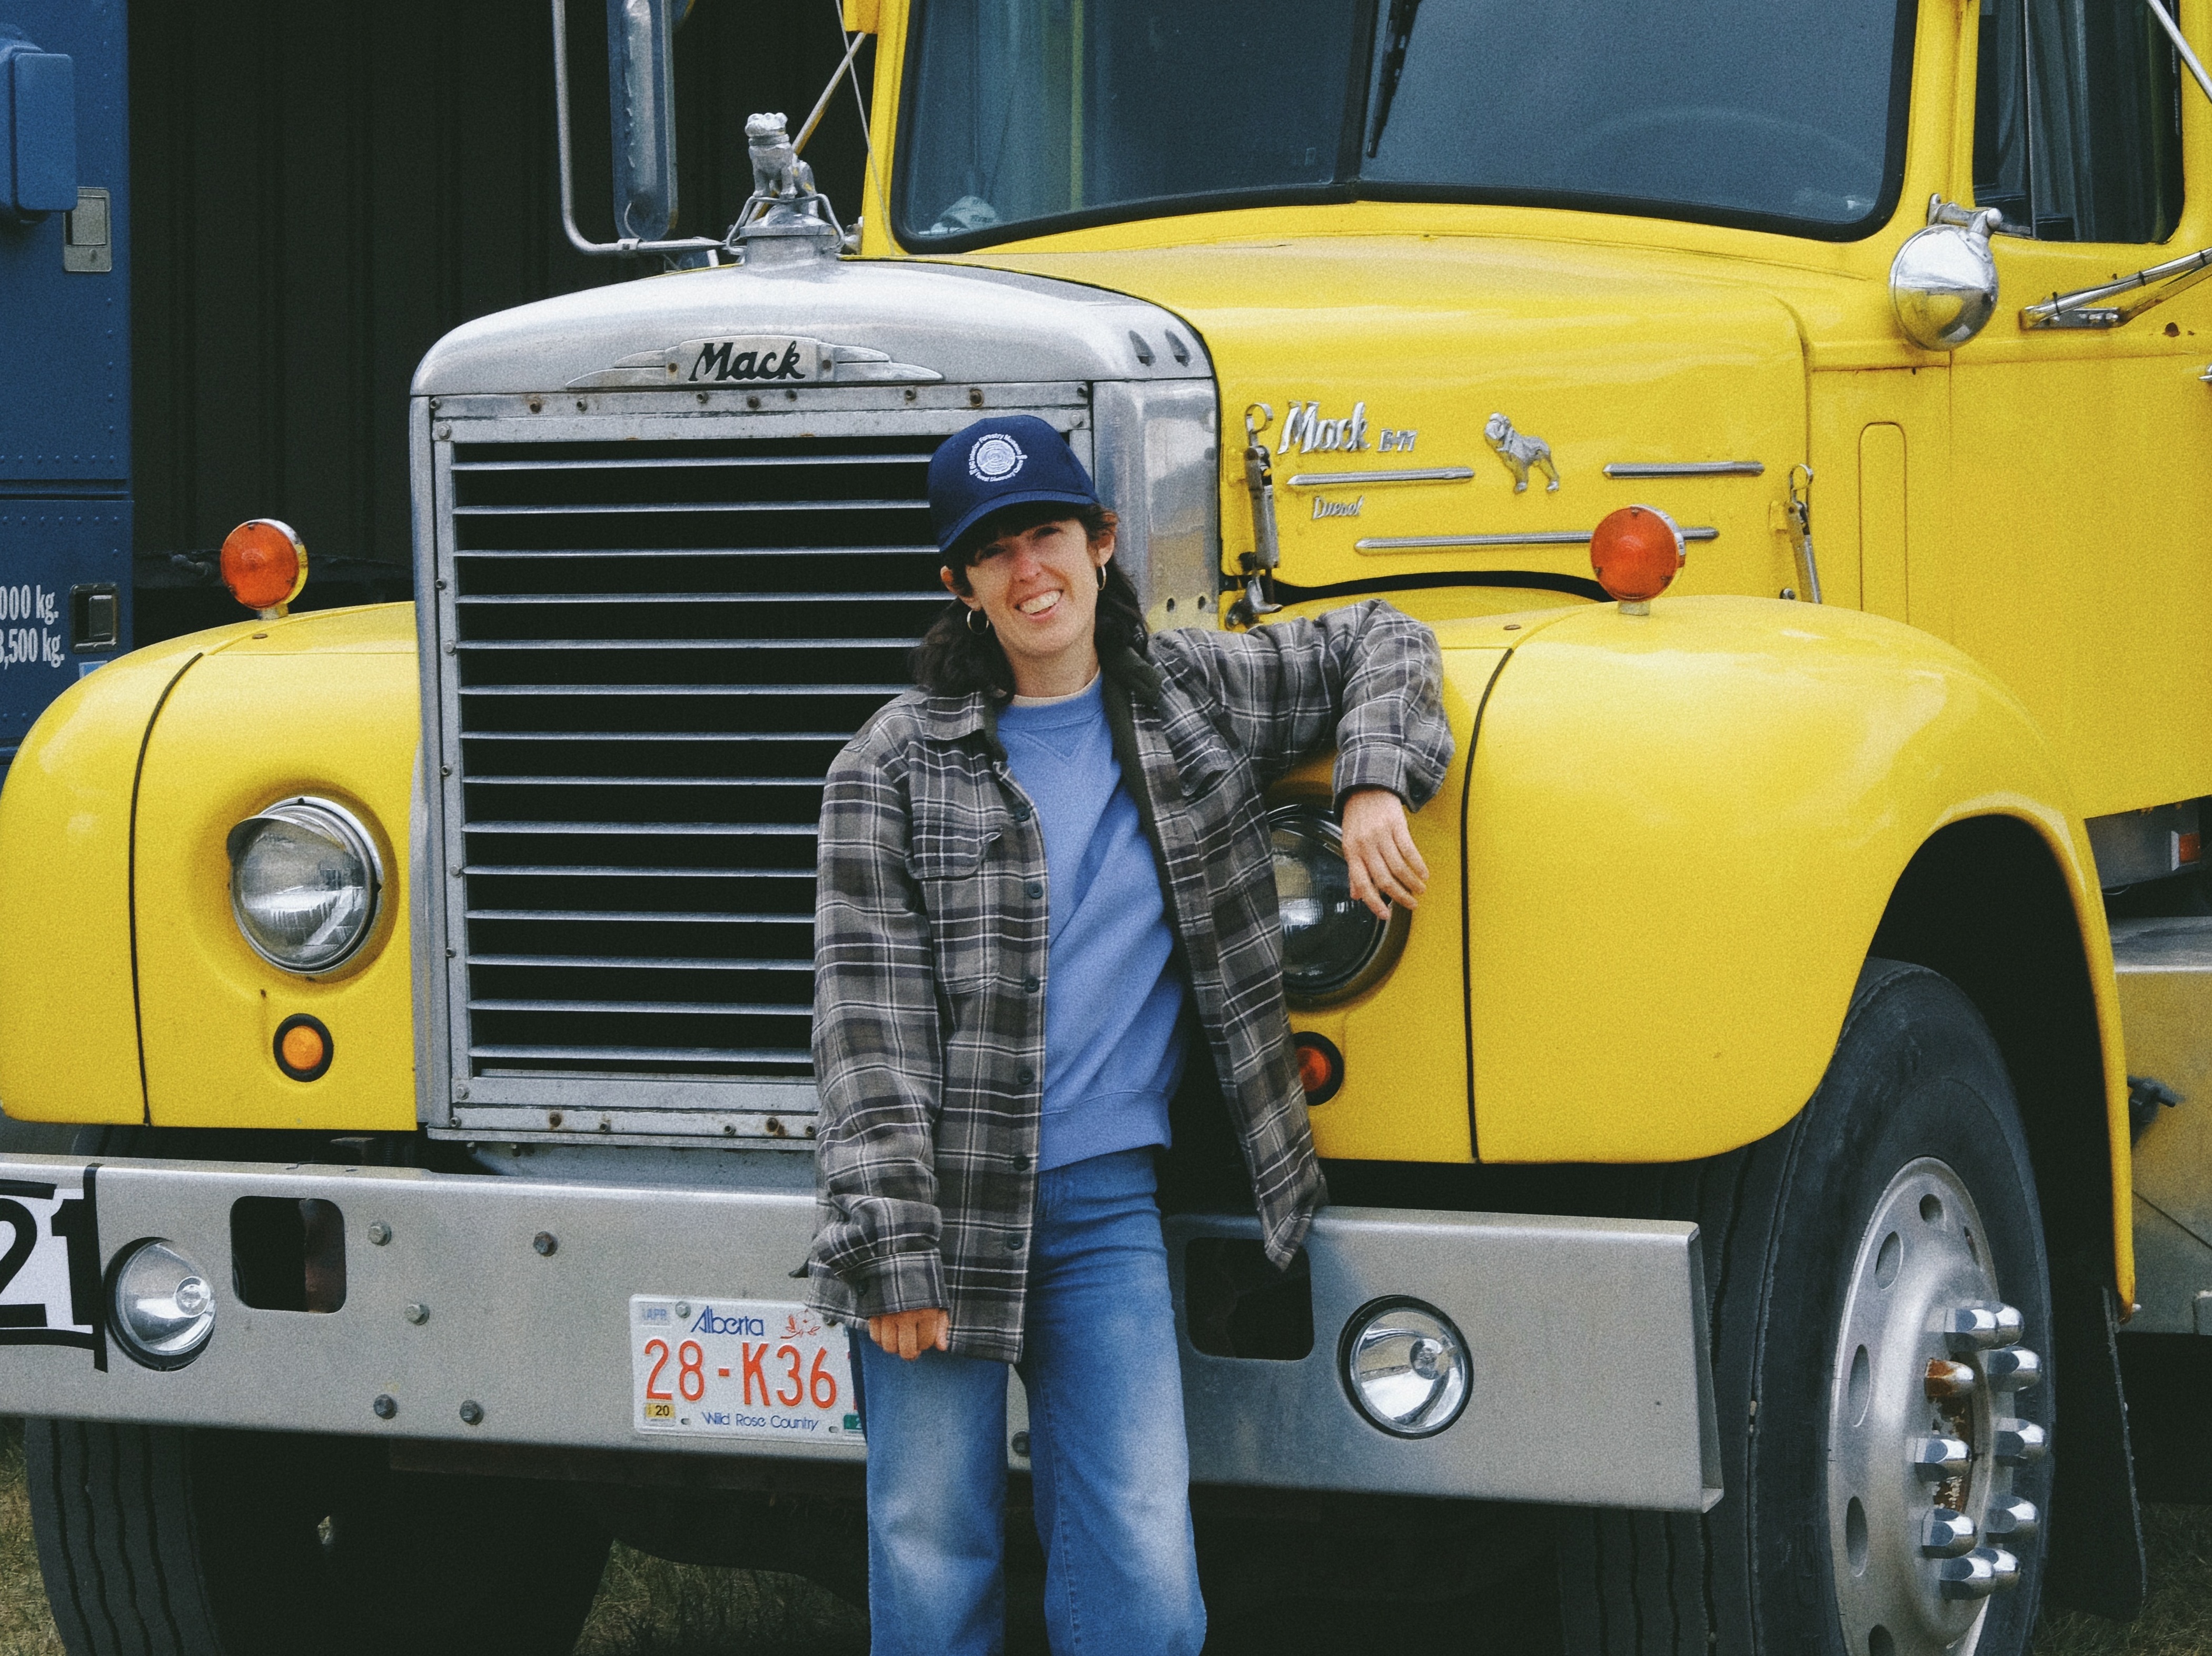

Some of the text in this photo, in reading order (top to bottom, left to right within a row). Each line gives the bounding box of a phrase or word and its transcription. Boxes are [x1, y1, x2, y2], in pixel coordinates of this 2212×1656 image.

[688, 340, 806, 382] Mack
[1277, 400, 1371, 455] Mack
[1312, 495, 1365, 520] Diesel
[36, 584, 59, 626] kg.
[42, 628, 65, 668] kg.
[690, 1305, 765, 1336] Alberta
[644, 1338, 857, 1410] 28-K36
[654, 1404, 670, 1416] 20
[701, 1411, 819, 1432] Wild Rose Country
